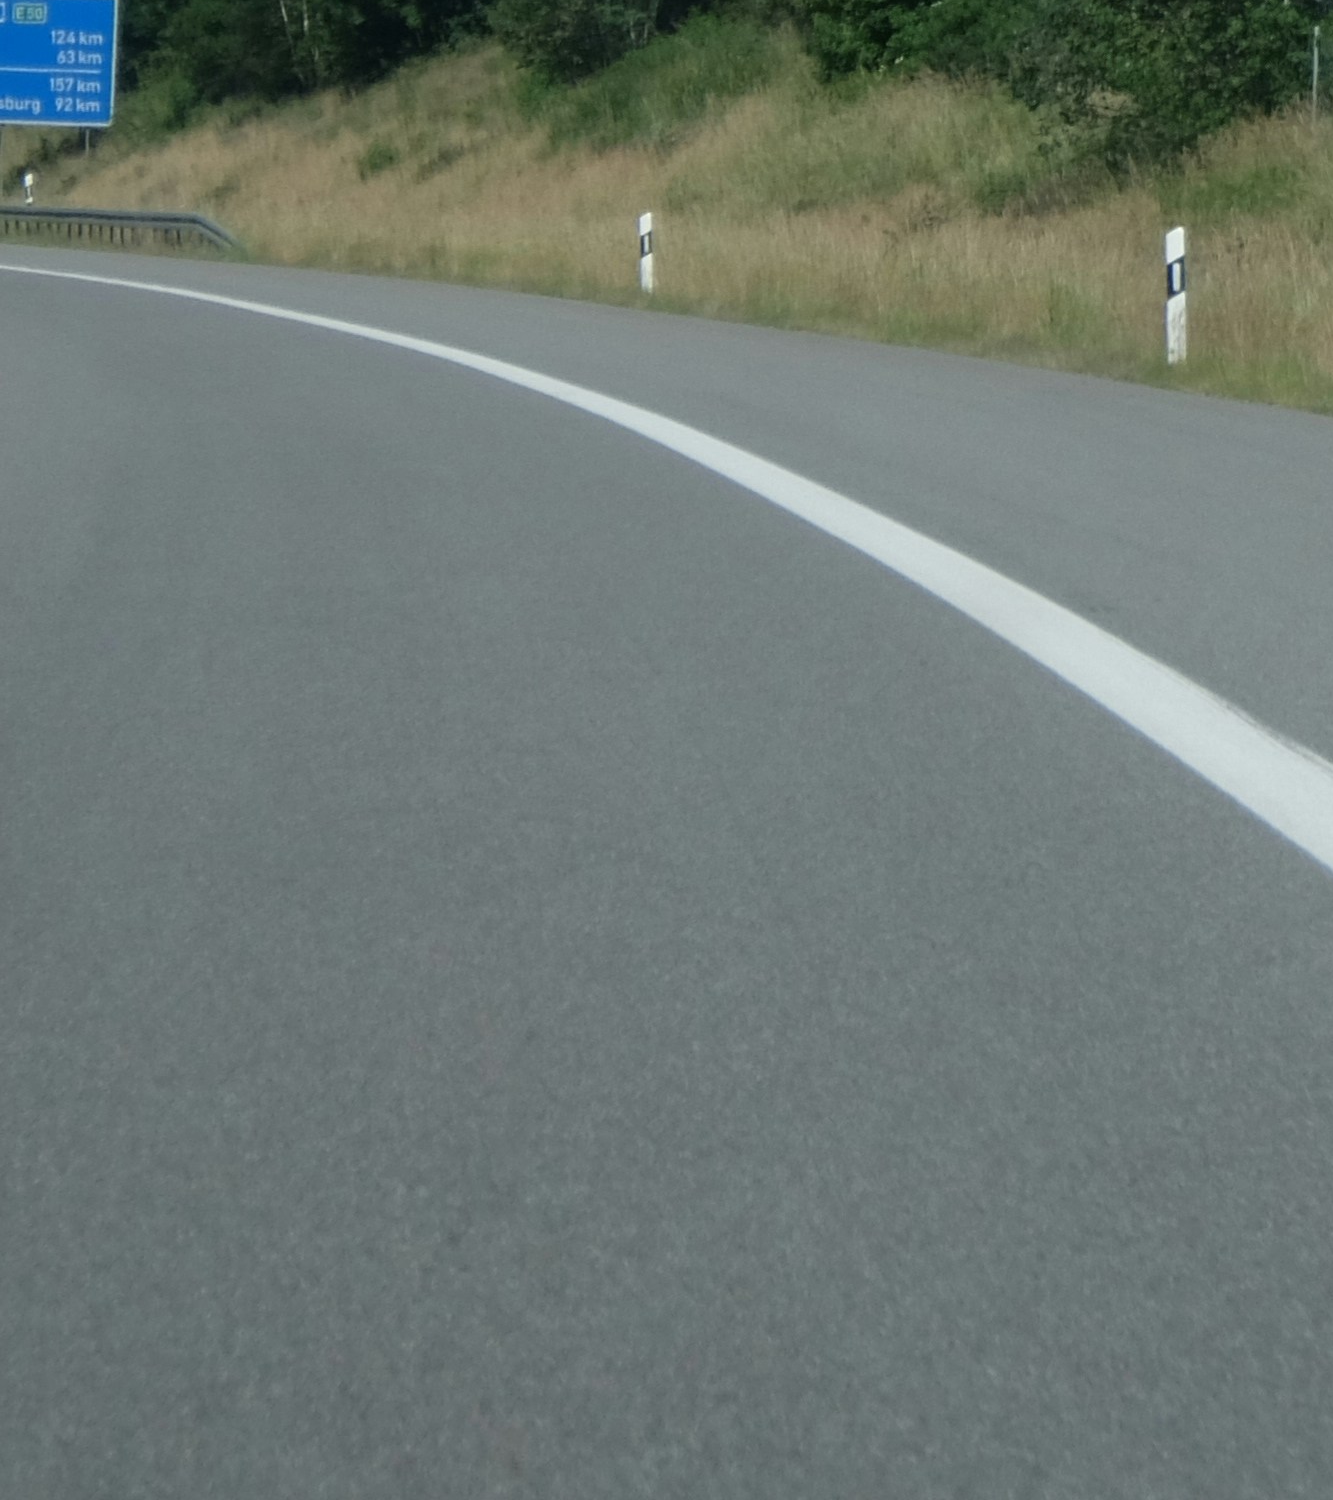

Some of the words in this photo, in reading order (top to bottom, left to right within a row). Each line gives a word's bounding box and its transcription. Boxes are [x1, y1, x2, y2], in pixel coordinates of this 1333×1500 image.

[51, 30, 76, 45] 124
[80, 31, 104, 46] km
[56, 50, 76, 65] 63
[79, 50, 103, 65] km
[49, 77, 74, 92] 157
[77, 79, 101, 93] km
[55, 98, 74, 112] 92
[76, 98, 100, 113] km
